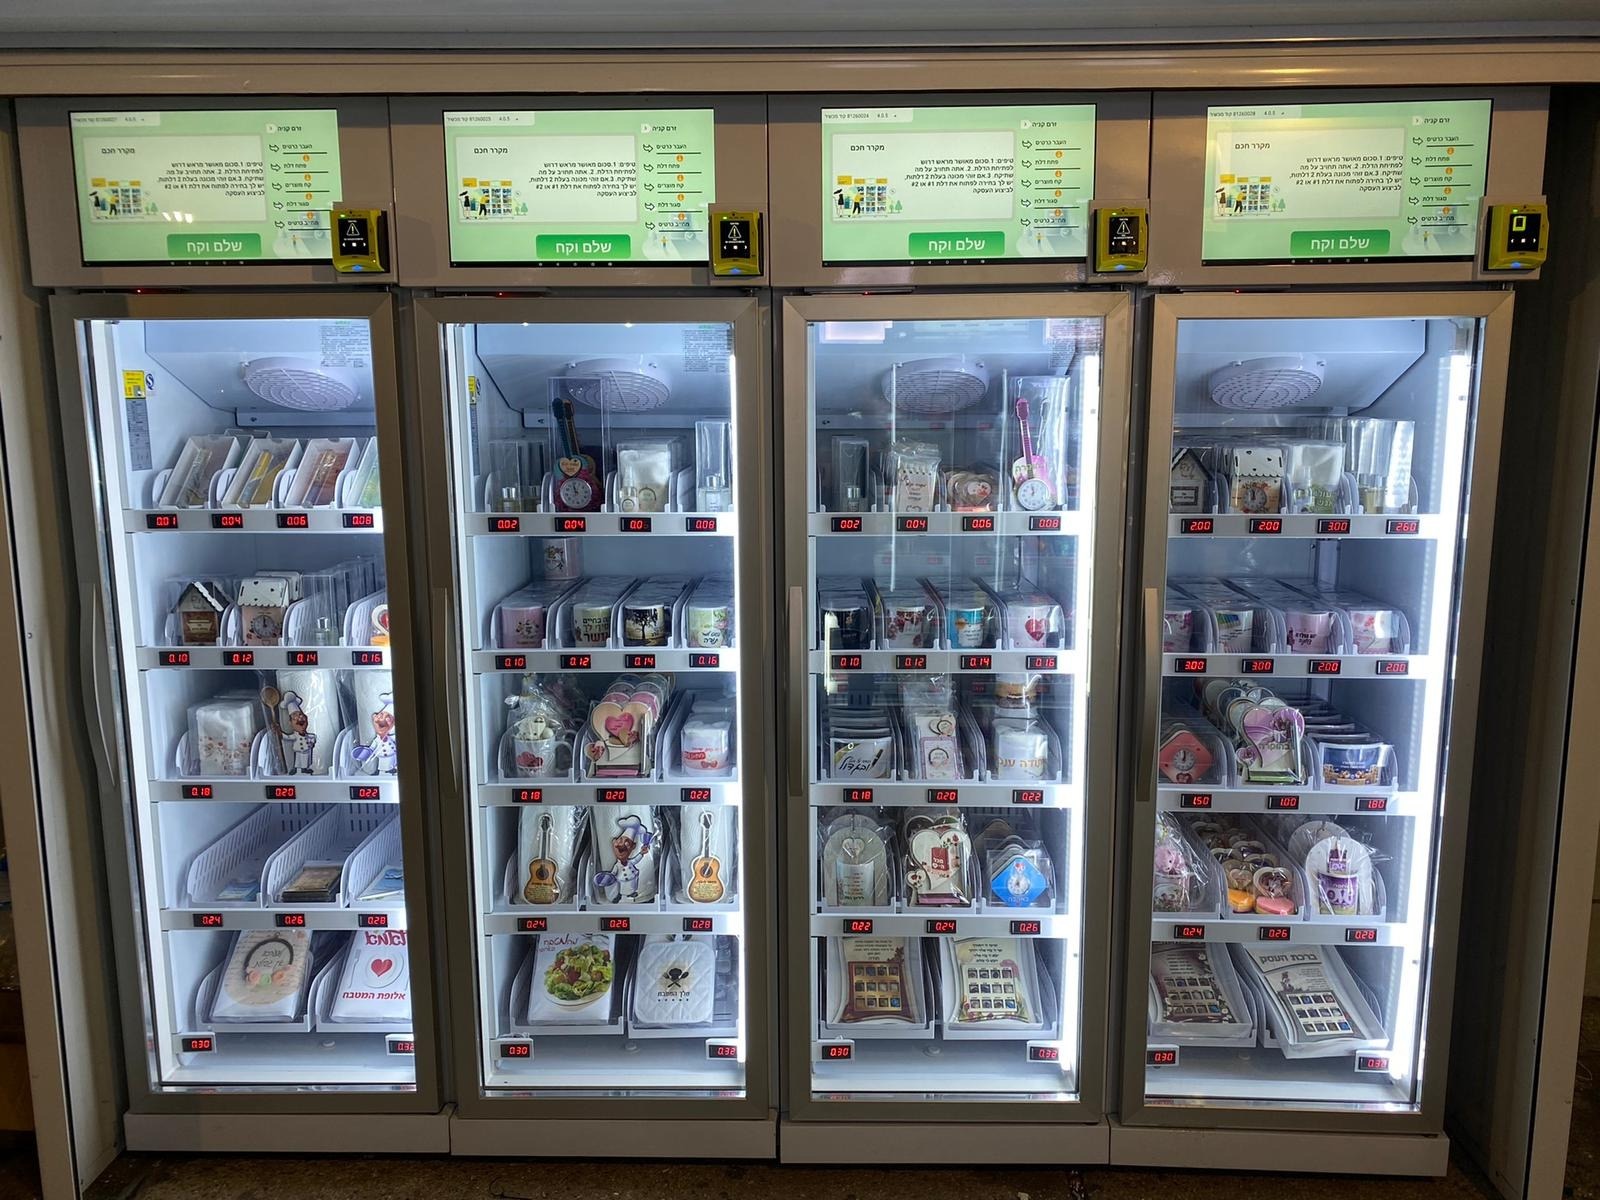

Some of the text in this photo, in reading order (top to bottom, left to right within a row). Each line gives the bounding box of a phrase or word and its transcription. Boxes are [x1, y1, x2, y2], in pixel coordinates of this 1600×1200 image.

[187, 238, 242, 255] שלם וקח
[556, 239, 611, 256] שלם וקח
[928, 237, 985, 254] שלם וקח
[1311, 235, 1370, 252] שלם וקח
[156, 516, 177, 527] 0.01
[221, 516, 241, 526] 0.04
[286, 515, 307, 526] 0.06
[352, 515, 372, 526] 0.08
[497, 519, 518, 529] 0.02
[564, 519, 584, 530] 0.04
[695, 519, 716, 530] 0.08
[840, 519, 860, 529] 0.02
[905, 519, 926, 529] 0.04
[971, 518, 992, 529] 0.06
[1190, 521, 1211, 531] 2.00
[1258, 521, 1280, 531] 2.00
[1327, 521, 1348, 531] 3.00
[168, 653, 188, 663] 0.10
[232, 653, 252, 664] 0.12
[296, 653, 316, 663] 0.14
[362, 654, 381, 663] 0.16
[504, 657, 524, 667] 0.10
[569, 656, 590, 667] 0.12
[634, 656, 654, 666] 0.14
[699, 656, 718, 665] 0.16
[840, 657, 860, 667] 0.10
[904, 657, 925, 667] 0.12
[969, 657, 990, 667] 0.14
[1035, 658, 1055, 668] 0.16
[1184, 660, 1205, 671] 3.00
[1252, 661, 1272, 671] 3.00
[1318, 661, 1339, 672] 2.00
[191, 787, 211, 797] 0.18
[275, 787, 294, 797] 0.20
[359, 788, 378, 798] 0.22
[520, 791, 541, 801] 0.18
[605, 790, 625, 800] 0.20
[690, 790, 710, 800] 0.22
[851, 790, 872, 800] 0.18
[936, 791, 957, 801] 0.20
[1021, 791, 1041, 802] 0.22
[1192, 796, 1210, 806] 1.50
[1280, 797, 1297, 807] 1.00
[1368, 800, 1384, 809] 1.80
[202, 915, 221, 925] 0.24
[367, 916, 387, 925] 0.28
[526, 920, 545, 929] 0.24
[609, 919, 628, 928] 0.26
[691, 919, 711, 929] 0.28
[935, 921, 955, 931] 0.24
[1019, 922, 1039, 933] 0.26
[1182, 927, 1203, 937] 0.24
[1268, 928, 1288, 938] 0.26
[1354, 930, 1376, 940] 0.28
[1259, 953, 1318, 964] ברכת העסק
[342, 991, 406, 1000] אלופת המטבח
[191, 1039, 210, 1049] 0.30
[509, 1046, 528, 1055] 0.30
[829, 1047, 849, 1057] 0.30
[1154, 1052, 1174, 1062] 0.30
